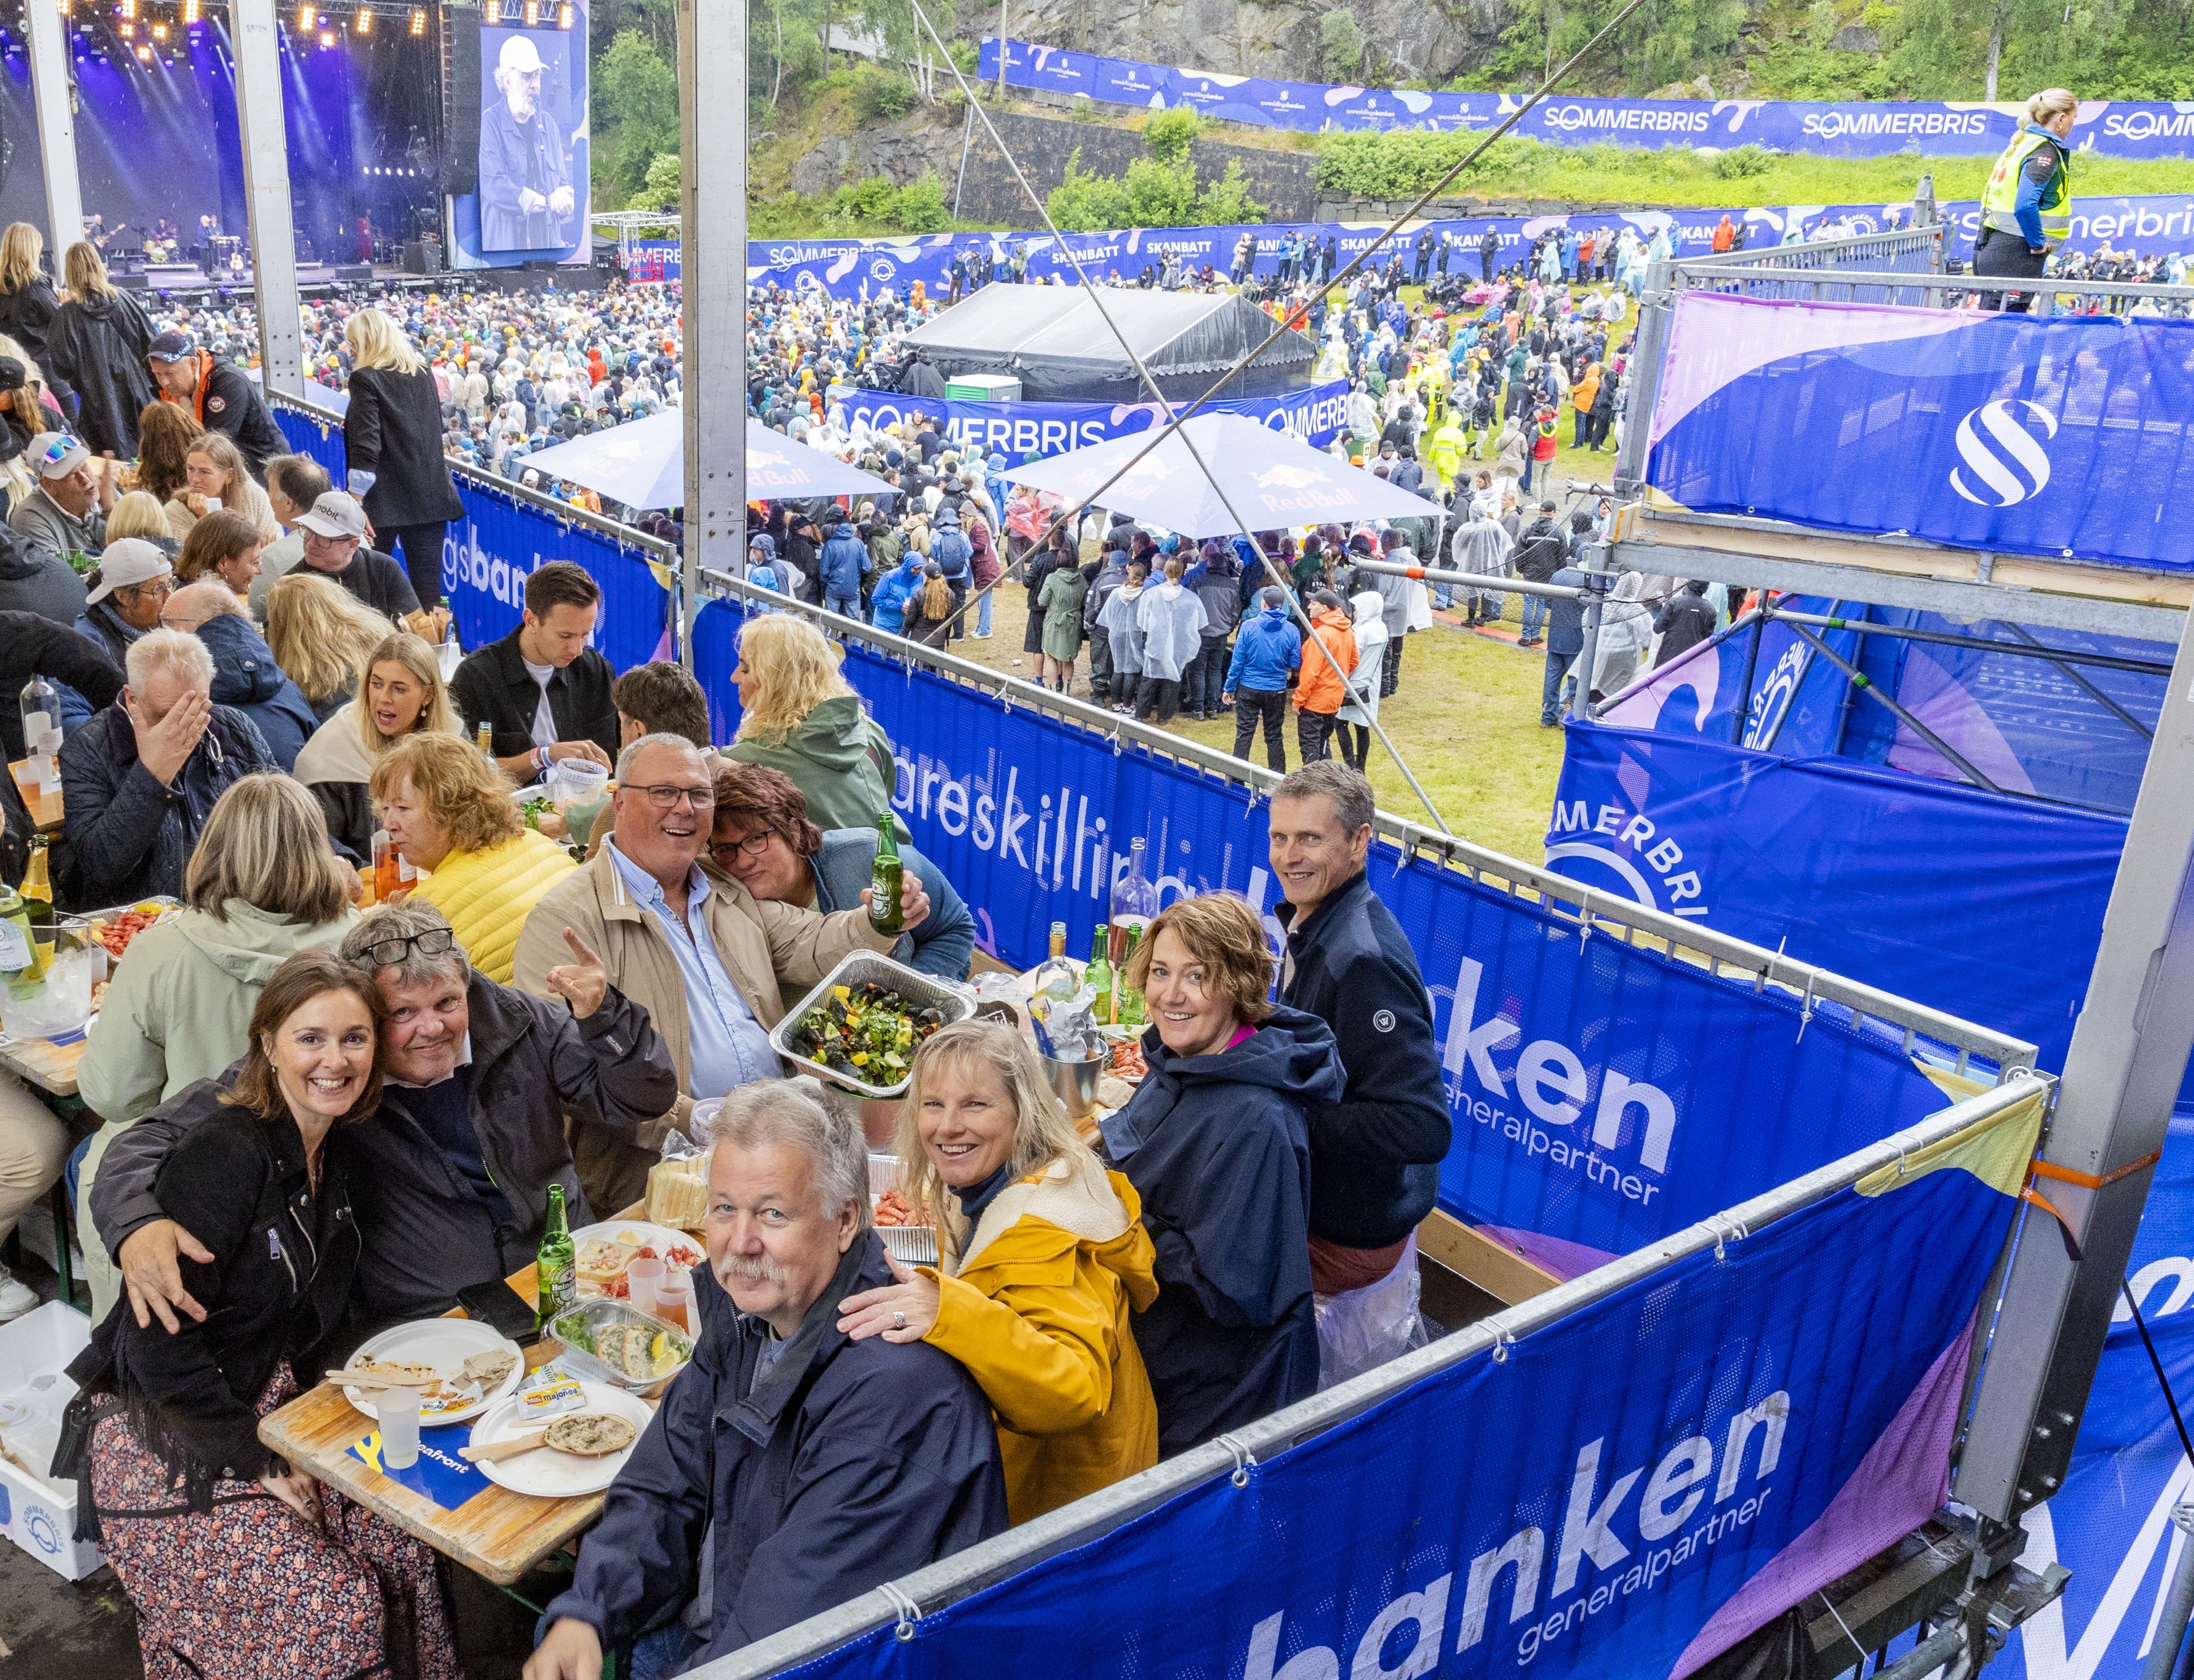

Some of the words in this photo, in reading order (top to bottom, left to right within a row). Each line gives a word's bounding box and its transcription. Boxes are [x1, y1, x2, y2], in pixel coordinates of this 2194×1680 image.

[1544, 105, 1709, 133] SOMMERBRIS
[1802, 111, 1986, 139] SOMMERBRIS
[1147, 241, 1212, 254] SKANBATT
[1548, 800, 1708, 916] MERBRI
[1443, 1081, 1660, 1206] eneralpartner
[418, 1440, 470, 1474] eafront
[1516, 1484, 1772, 1667] generalpartner
